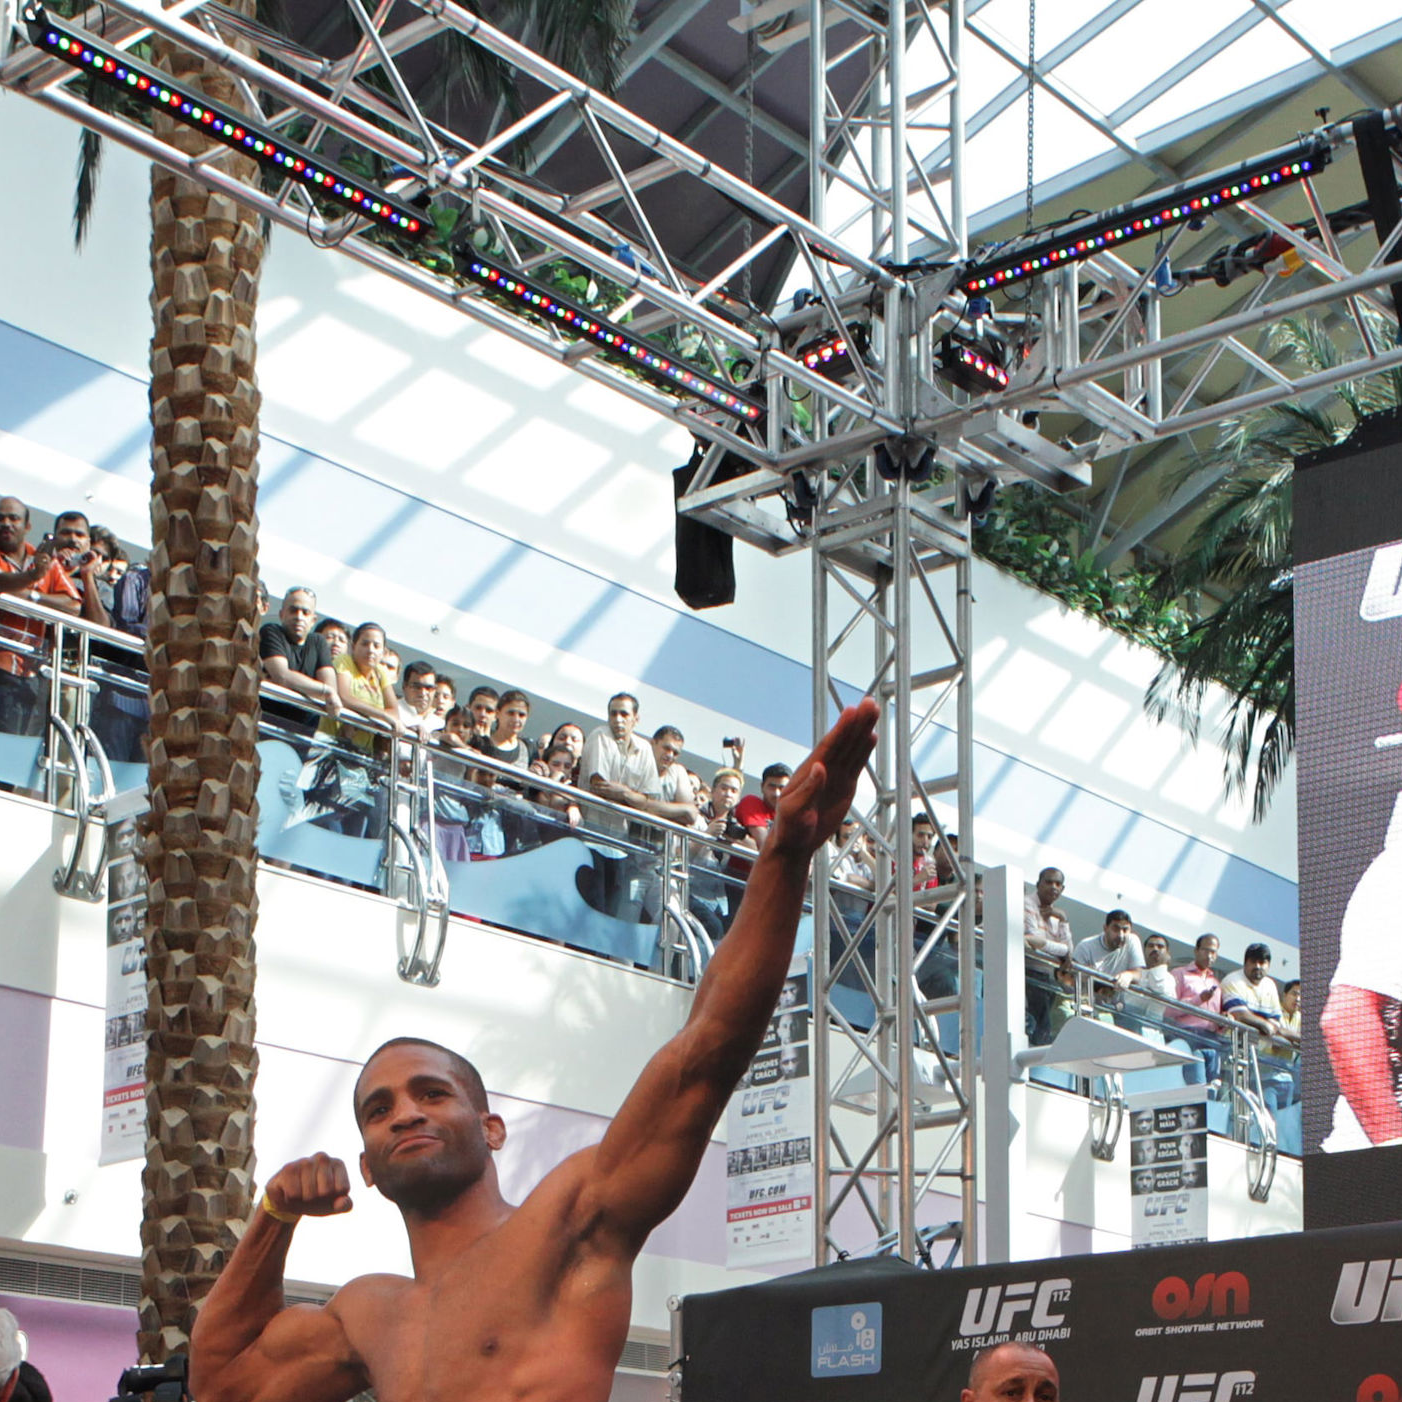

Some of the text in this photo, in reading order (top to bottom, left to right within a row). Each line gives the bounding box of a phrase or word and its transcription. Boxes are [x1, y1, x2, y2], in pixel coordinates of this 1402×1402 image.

[741, 1085, 791, 1117] UFC
[1144, 1193, 1190, 1217] UFC
[959, 1278, 1072, 1336] UFC 112
[951, 1339, 970, 1351] YAS
[1015, 1330, 1036, 1342] ABU
[1038, 1328, 1071, 1340] DHABI
[1135, 1319, 1265, 1337] ORBIT SHOWTIME NETWORK
[817, 1353, 875, 1369] FLASH
[1234, 1383, 1255, 1395] 112
